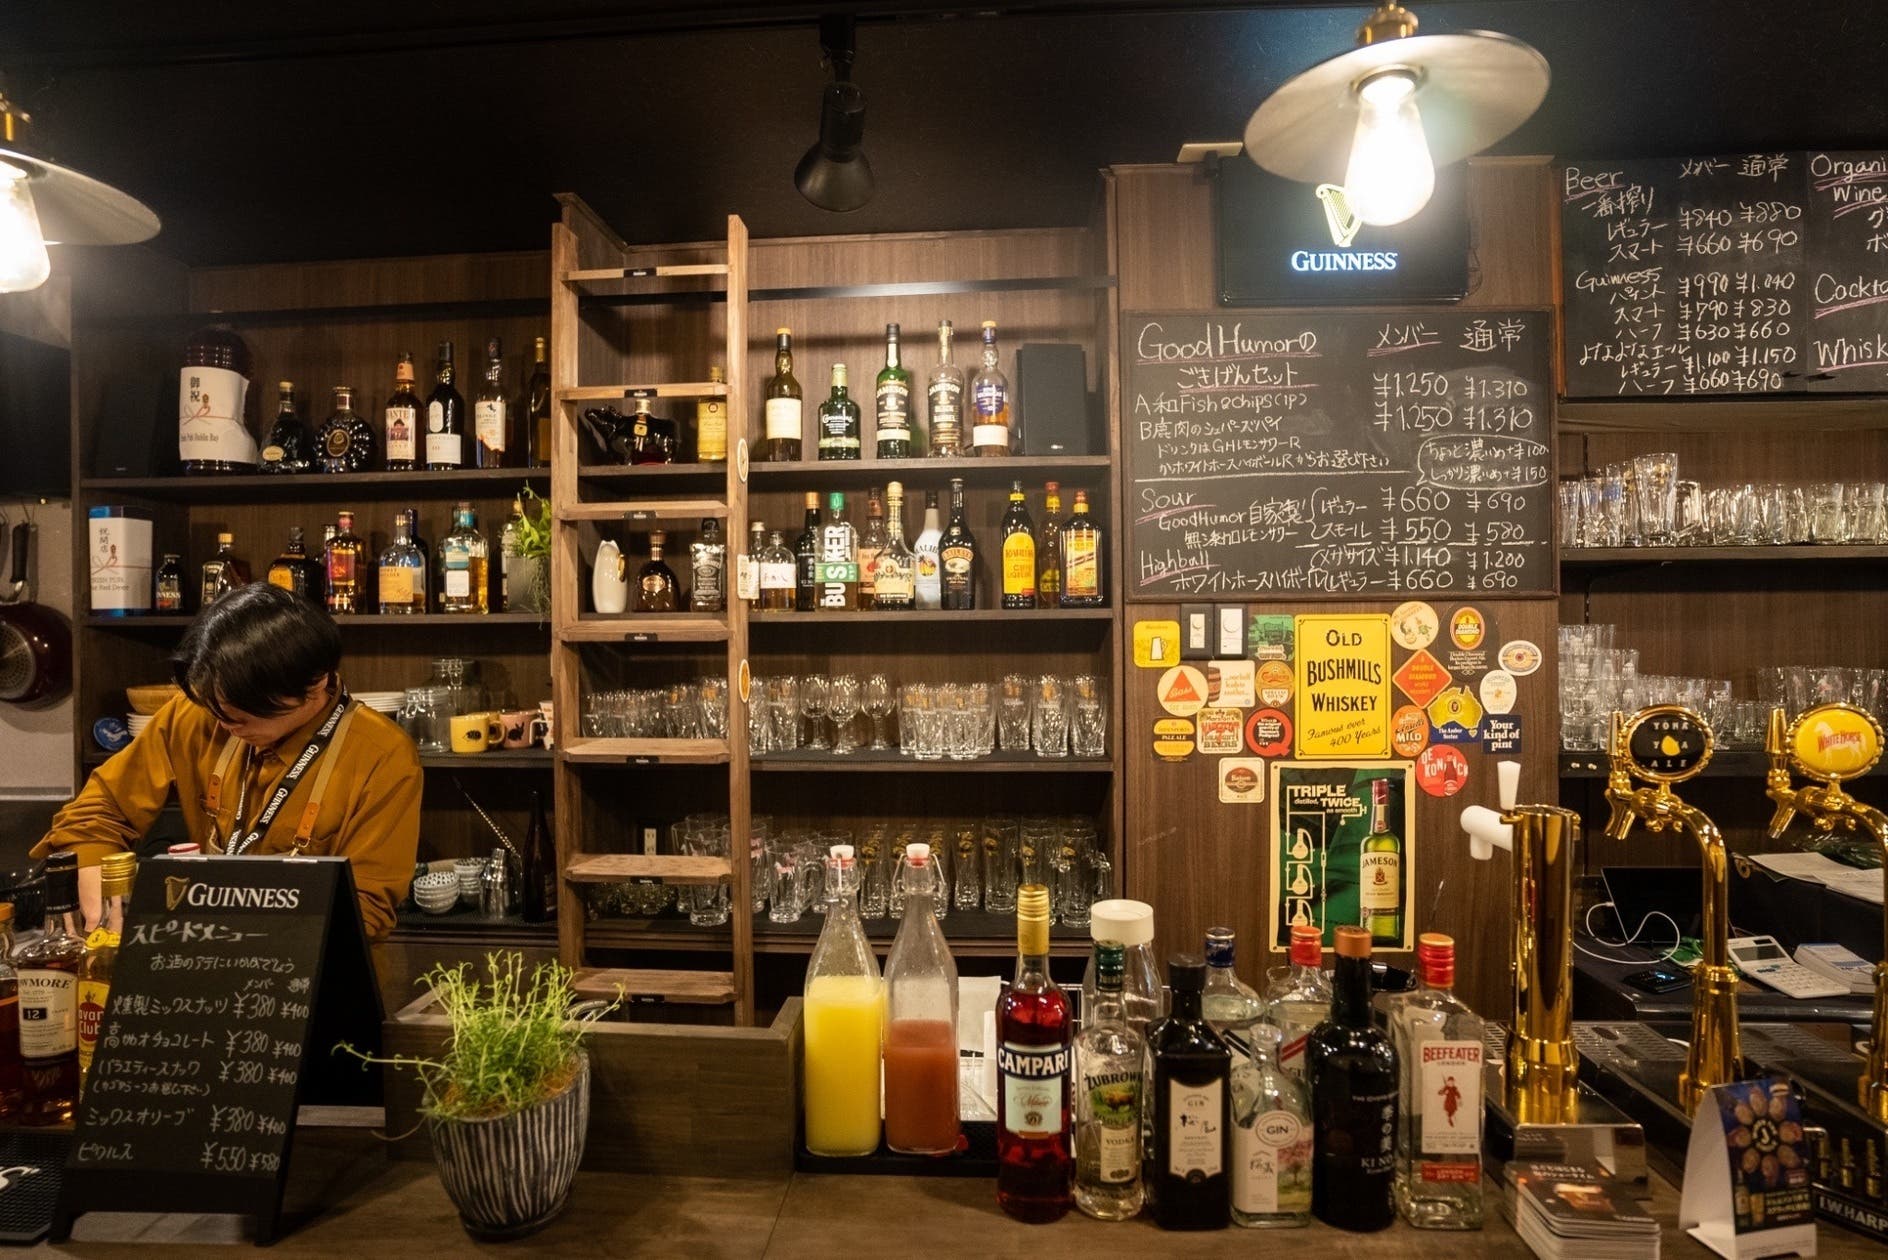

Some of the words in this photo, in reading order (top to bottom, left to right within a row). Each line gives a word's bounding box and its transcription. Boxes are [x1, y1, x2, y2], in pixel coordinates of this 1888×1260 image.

[1737, 153, 1789, 182] 通常
[1566, 166, 1623, 195] Beer
[1833, 185, 1882, 202] Wine
[1607, 217, 1668, 241] レギュラー
[1679, 207, 1733, 230] ¥840
[1739, 201, 1801, 224] ¥880
[1608, 238, 1663, 263] スマート
[1676, 231, 1731, 256] ¥660
[1737, 228, 1798, 254] ¥690
[1291, 250, 1399, 274] GUINNESS
[1614, 302, 1666, 325] スマート
[1678, 299, 1728, 322] ¥790
[1733, 299, 1791, 319] ¥830
[1376, 322, 1439, 349] メンバー
[1458, 318, 1526, 352] 通常
[1615, 323, 1662, 341] ハーフ
[1677, 322, 1730, 341] ¥630
[1733, 320, 1791, 340] ¥660
[1176, 361, 1299, 389] ごきげんセット
[1618, 379, 1675, 395] ハーフ
[1683, 368, 1730, 394] ¥660
[1731, 368, 1783, 392] ¥690
[1621, 361, 1678, 379] レギュラー
[1141, 488, 1197, 513] Sour
[1321, 495, 1368, 516] レギュラー
[1380, 486, 1451, 512] ¥660
[1466, 490, 1526, 513] ¥690
[1321, 520, 1373, 539] スモール
[1379, 516, 1452, 541] ¥550
[1464, 520, 1525, 543] ¥580
[824, 525, 848, 607] BUSKER
[1140, 549, 1211, 579] Highball
[1329, 570, 1386, 592] レギュラー
[1387, 568, 1454, 591] ¥660
[1467, 570, 1518, 590] ¥690
[1326, 629, 1362, 646] OLD
[1307, 658, 1382, 688] BUSHMILLS
[1311, 692, 1378, 712] WHISKEY
[316, 703, 345, 737] GUINNESS
[1307, 724, 1346, 741] Famous
[1346, 718, 1366, 730] over
[1489, 719, 1515, 730] Your
[1652, 722, 1690, 731] YONA
[1354, 726, 1382, 745] Years
[1396, 732, 1422, 743] MILD
[1483, 729, 1508, 739] kind
[1509, 729, 1520, 739] of
[1491, 739, 1513, 752] pint
[1817, 732, 1842, 753] WHITE
[286, 744, 319, 780] GUINNESS
[1421, 748, 1433, 765] DE
[1651, 760, 1687, 768] ALE
[1292, 784, 1347, 798] TRIPLE
[1320, 797, 1361, 808] TWICE
[259, 787, 289, 825] GUINNESS
[1362, 856, 1398, 869] JAMESON
[187, 882, 301, 910] GUINNESS
[126, 919, 270, 948] スピードメニュー
[27, 1009, 40, 1020] 12
[233, 991, 276, 1020] ¥380
[280, 1000, 310, 1019] ¥400
[226, 1029, 269, 1058] ¥380
[271, 1039, 302, 1059] ¥400
[1422, 1046, 1480, 1063] BEEFEATER
[218, 1060, 264, 1084] ¥380
[267, 1066, 298, 1085] ¥400
[998, 1048, 1069, 1076] CAMPARI
[84, 1106, 195, 1127] ミックスオリーブ
[209, 1103, 255, 1133] ¥380
[257, 1113, 287, 1135] ¥400
[1266, 1125, 1290, 1135] GIN
[77, 1141, 134, 1162] ピクルス
[201, 1141, 246, 1171] ¥550
[249, 1151, 281, 1172] ¥580
